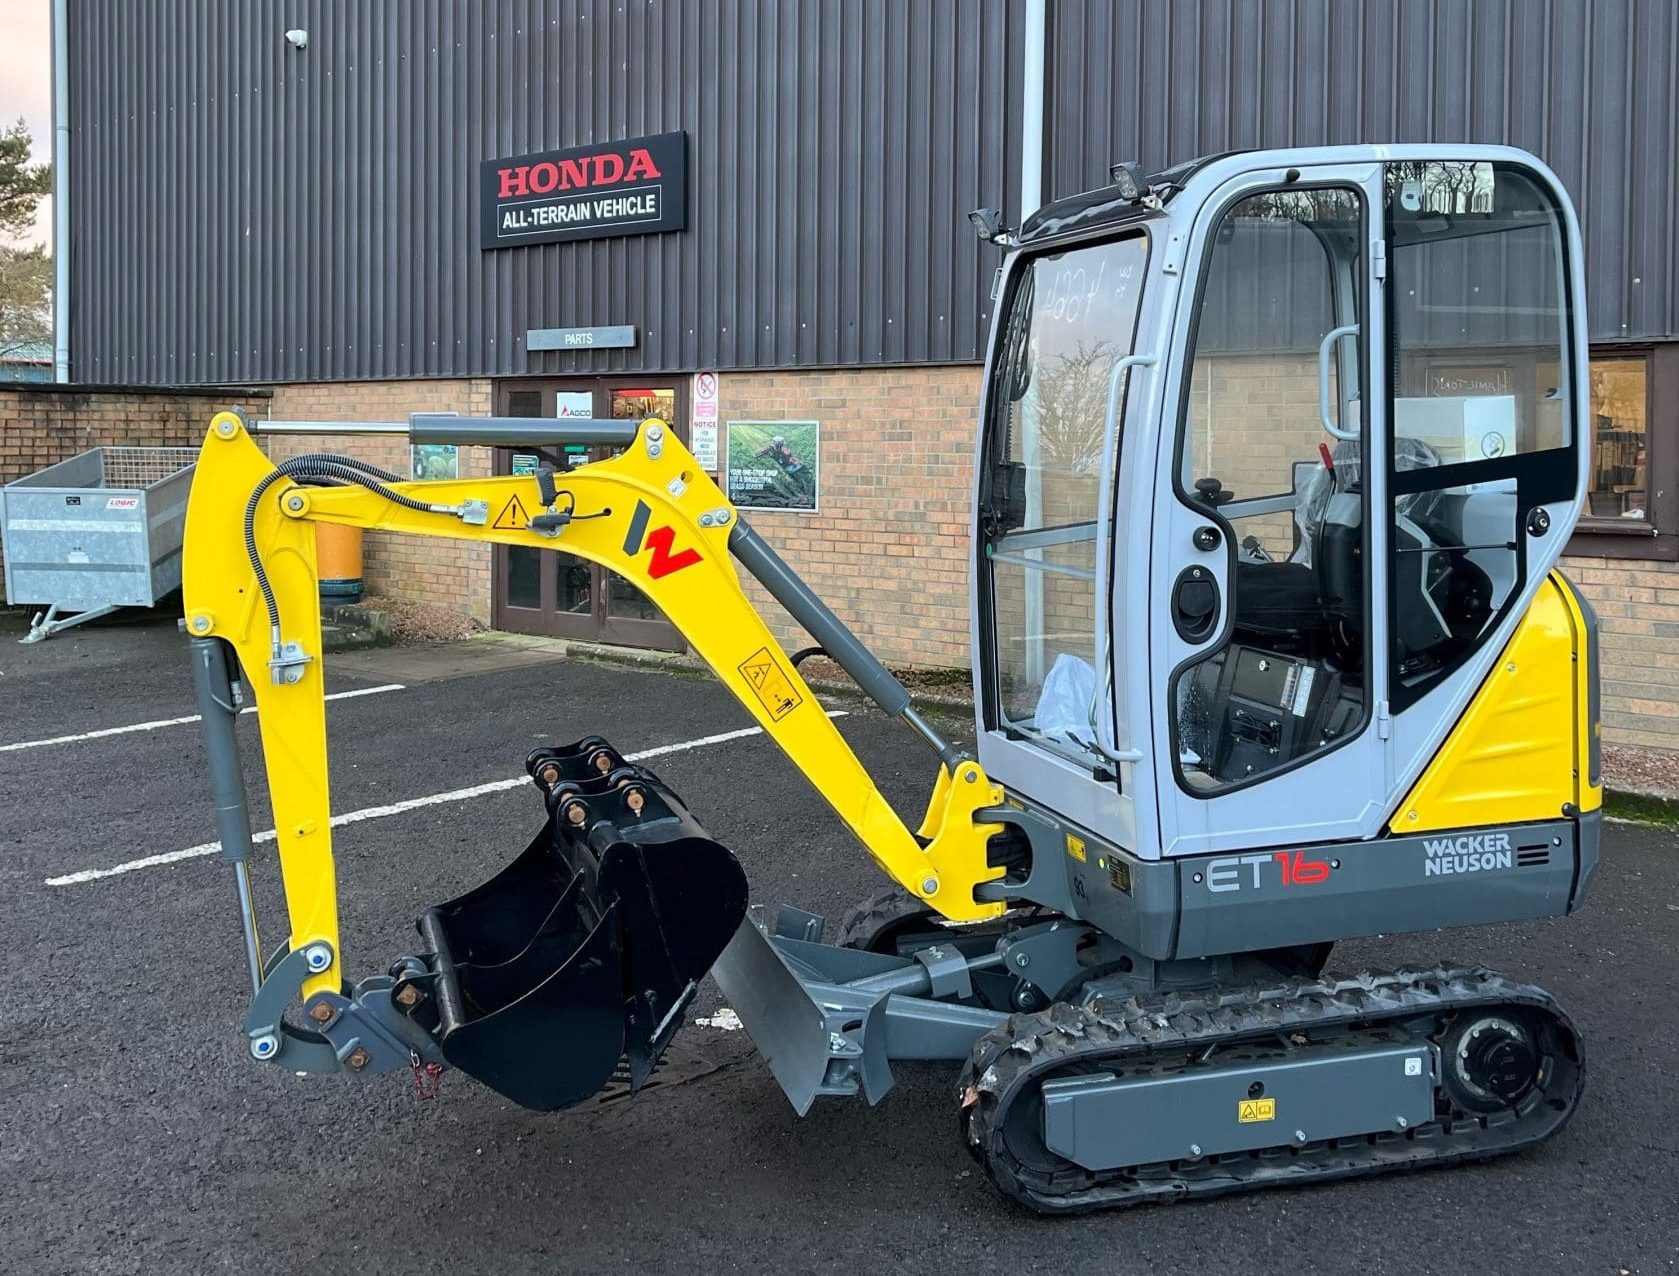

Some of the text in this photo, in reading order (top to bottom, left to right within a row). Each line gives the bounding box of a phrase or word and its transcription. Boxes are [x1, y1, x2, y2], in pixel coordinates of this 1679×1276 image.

[498, 149, 661, 198] HONDA
[502, 194, 656, 229] ALL-TERRAIN VEHICLE
[565, 333, 593, 345] PARTS
[569, 409, 591, 417] AGCO
[1423, 833, 1511, 857] WACKER
[1425, 850, 1512, 876] NEUSON
